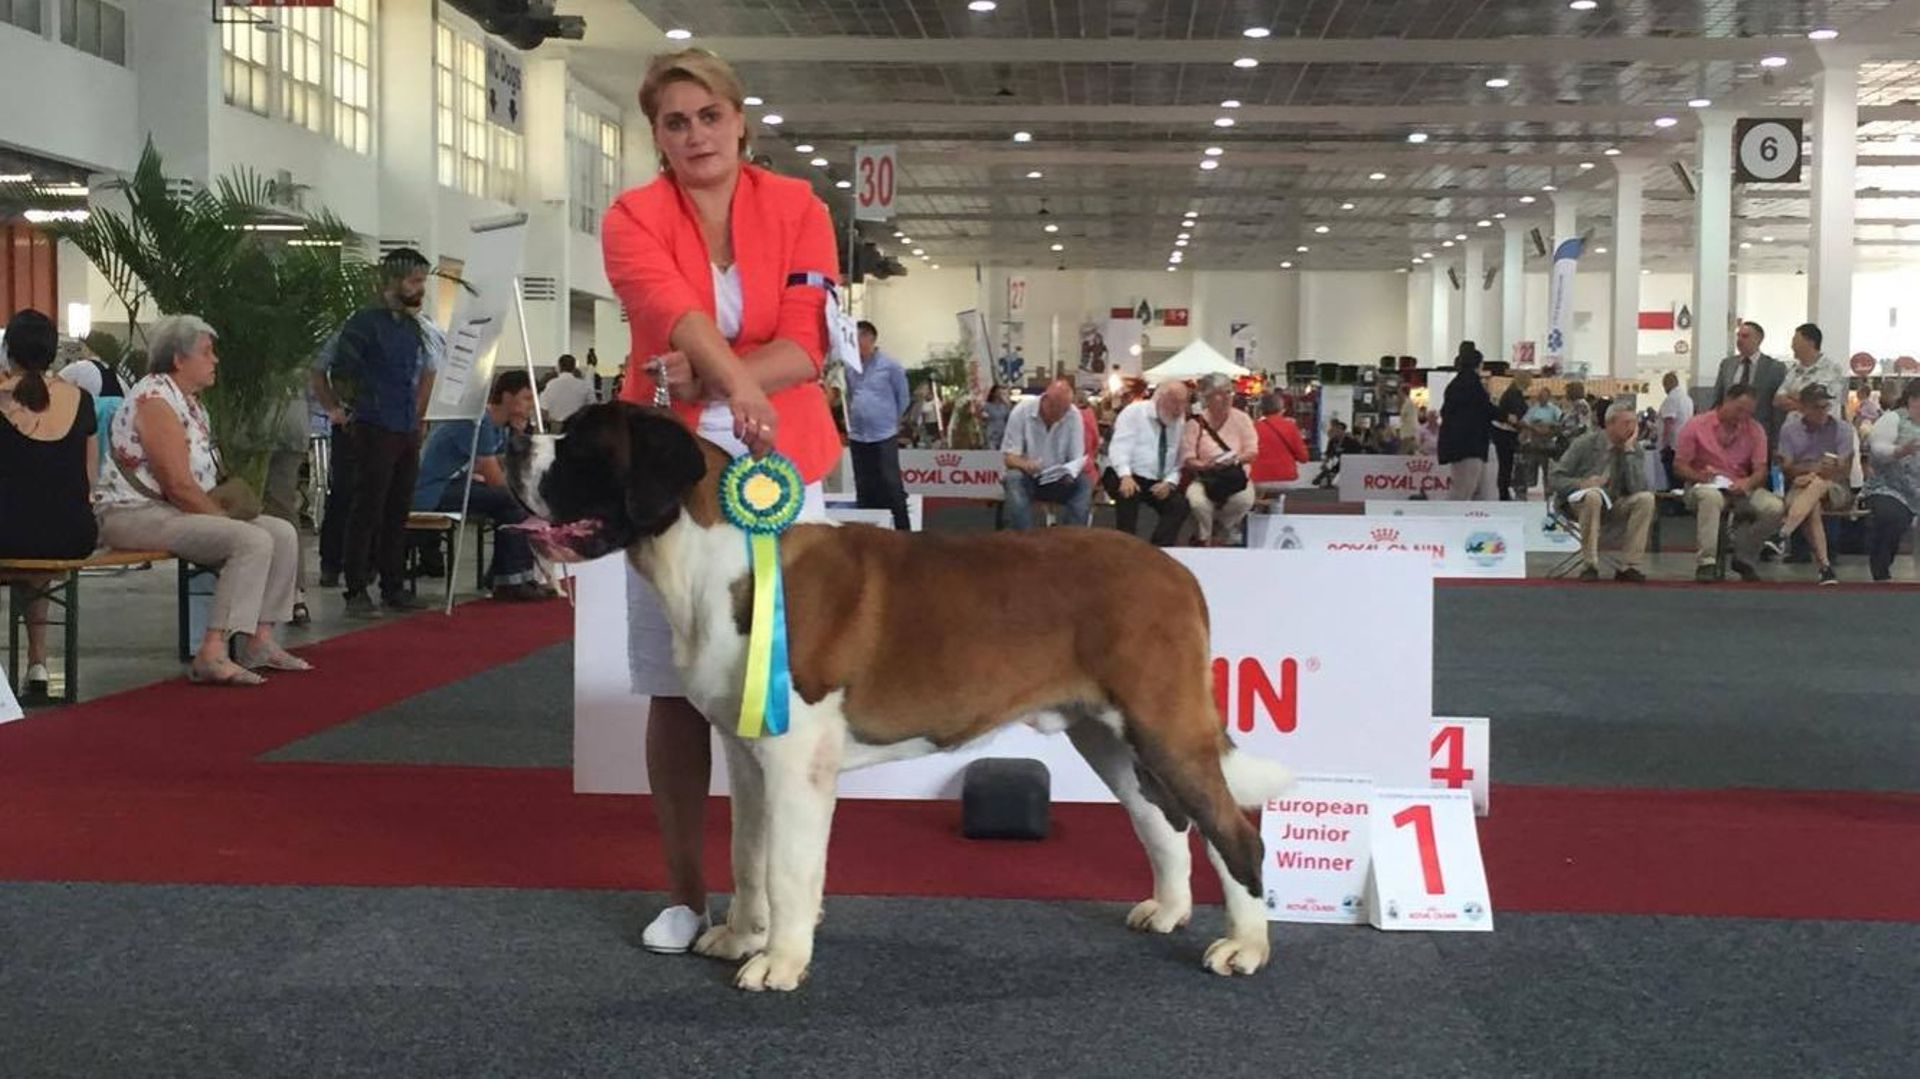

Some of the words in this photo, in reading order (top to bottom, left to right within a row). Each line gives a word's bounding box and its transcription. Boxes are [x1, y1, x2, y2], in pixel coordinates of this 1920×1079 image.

[1760, 136, 1778, 162] 6
[859, 154, 894, 208] 30
[1011, 281, 1026, 310] 27
[1364, 474, 1417, 490] ROYAL
[1430, 726, 1474, 789] 4
[1266, 798, 1369, 817] European
[1281, 823, 1350, 842] Junior
[1276, 850, 1354, 871] Winner
[1393, 804, 1445, 895] 1
